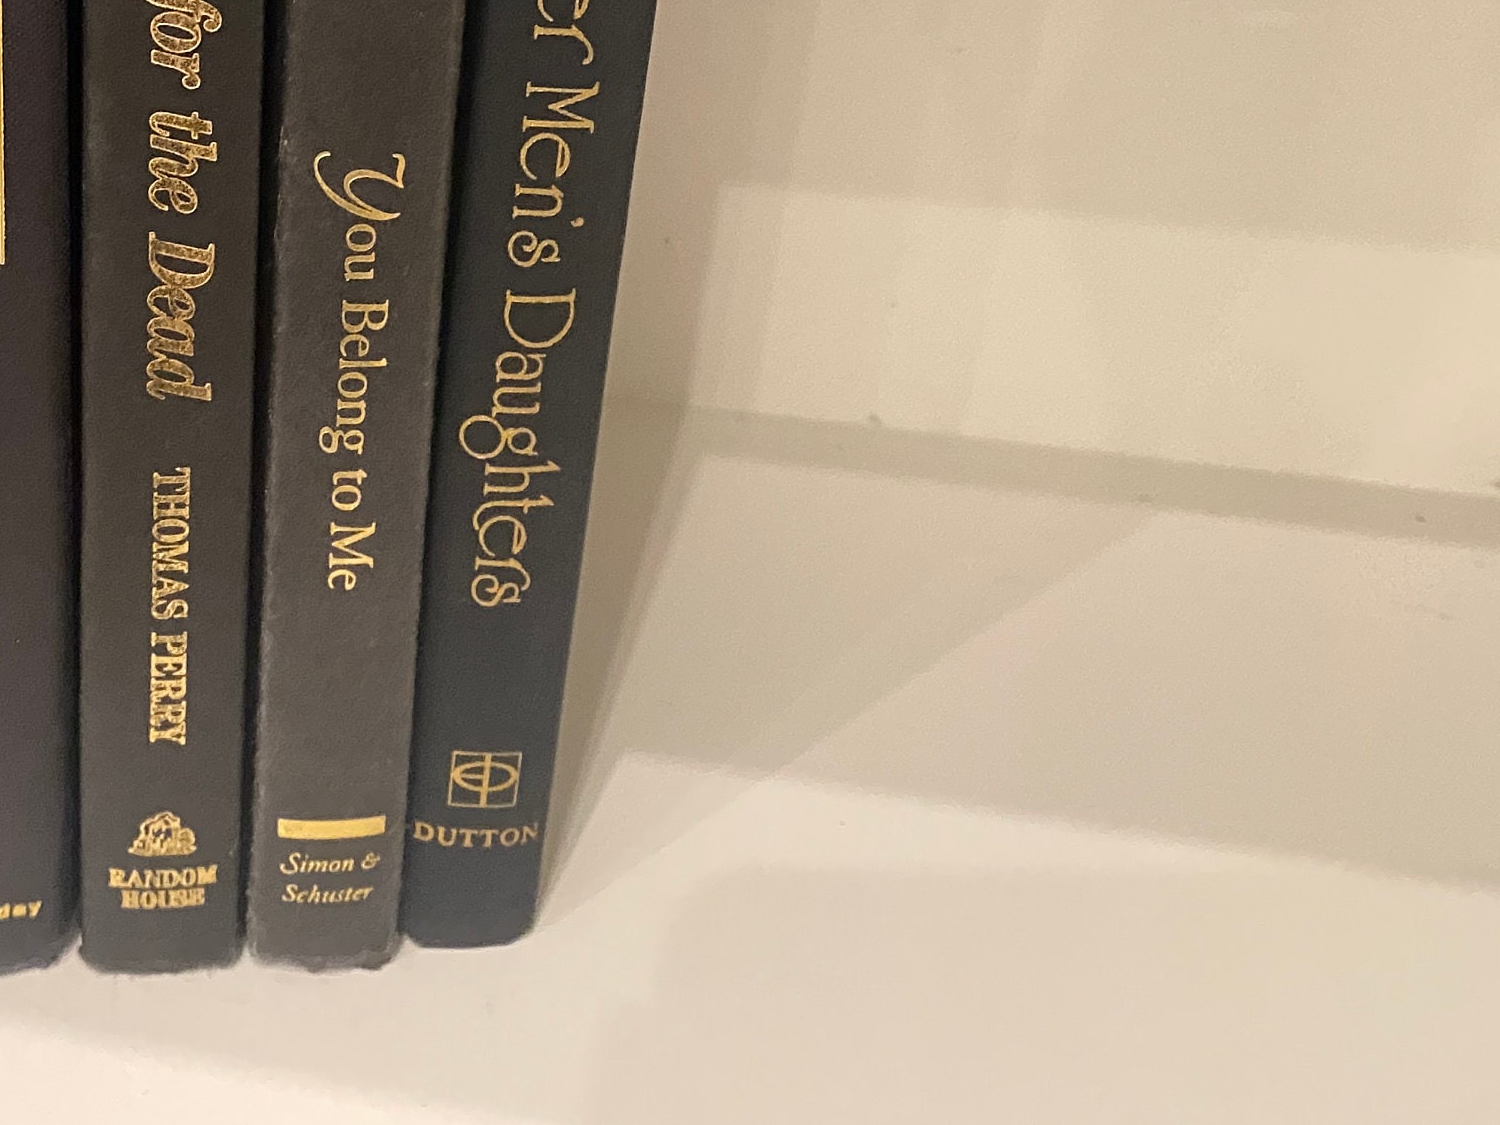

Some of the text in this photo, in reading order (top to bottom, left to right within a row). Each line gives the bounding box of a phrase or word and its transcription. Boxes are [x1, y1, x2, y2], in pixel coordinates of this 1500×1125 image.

[148, 112, 217, 214] the
[508, 82, 599, 267] Men's
[146, 232, 215, 401] Dead
[314, 151, 405, 590] You Belong to Me
[459, 288, 577, 608] Daughters
[149, 467, 190, 745] THOMAS PERRY
[109, 865, 217, 888] RANDOM
[280, 852, 380, 875] Simon &
[414, 821, 539, 849] DUTTON
[121, 887, 205, 909] HOUSE
[282, 884, 373, 904] Schuster
